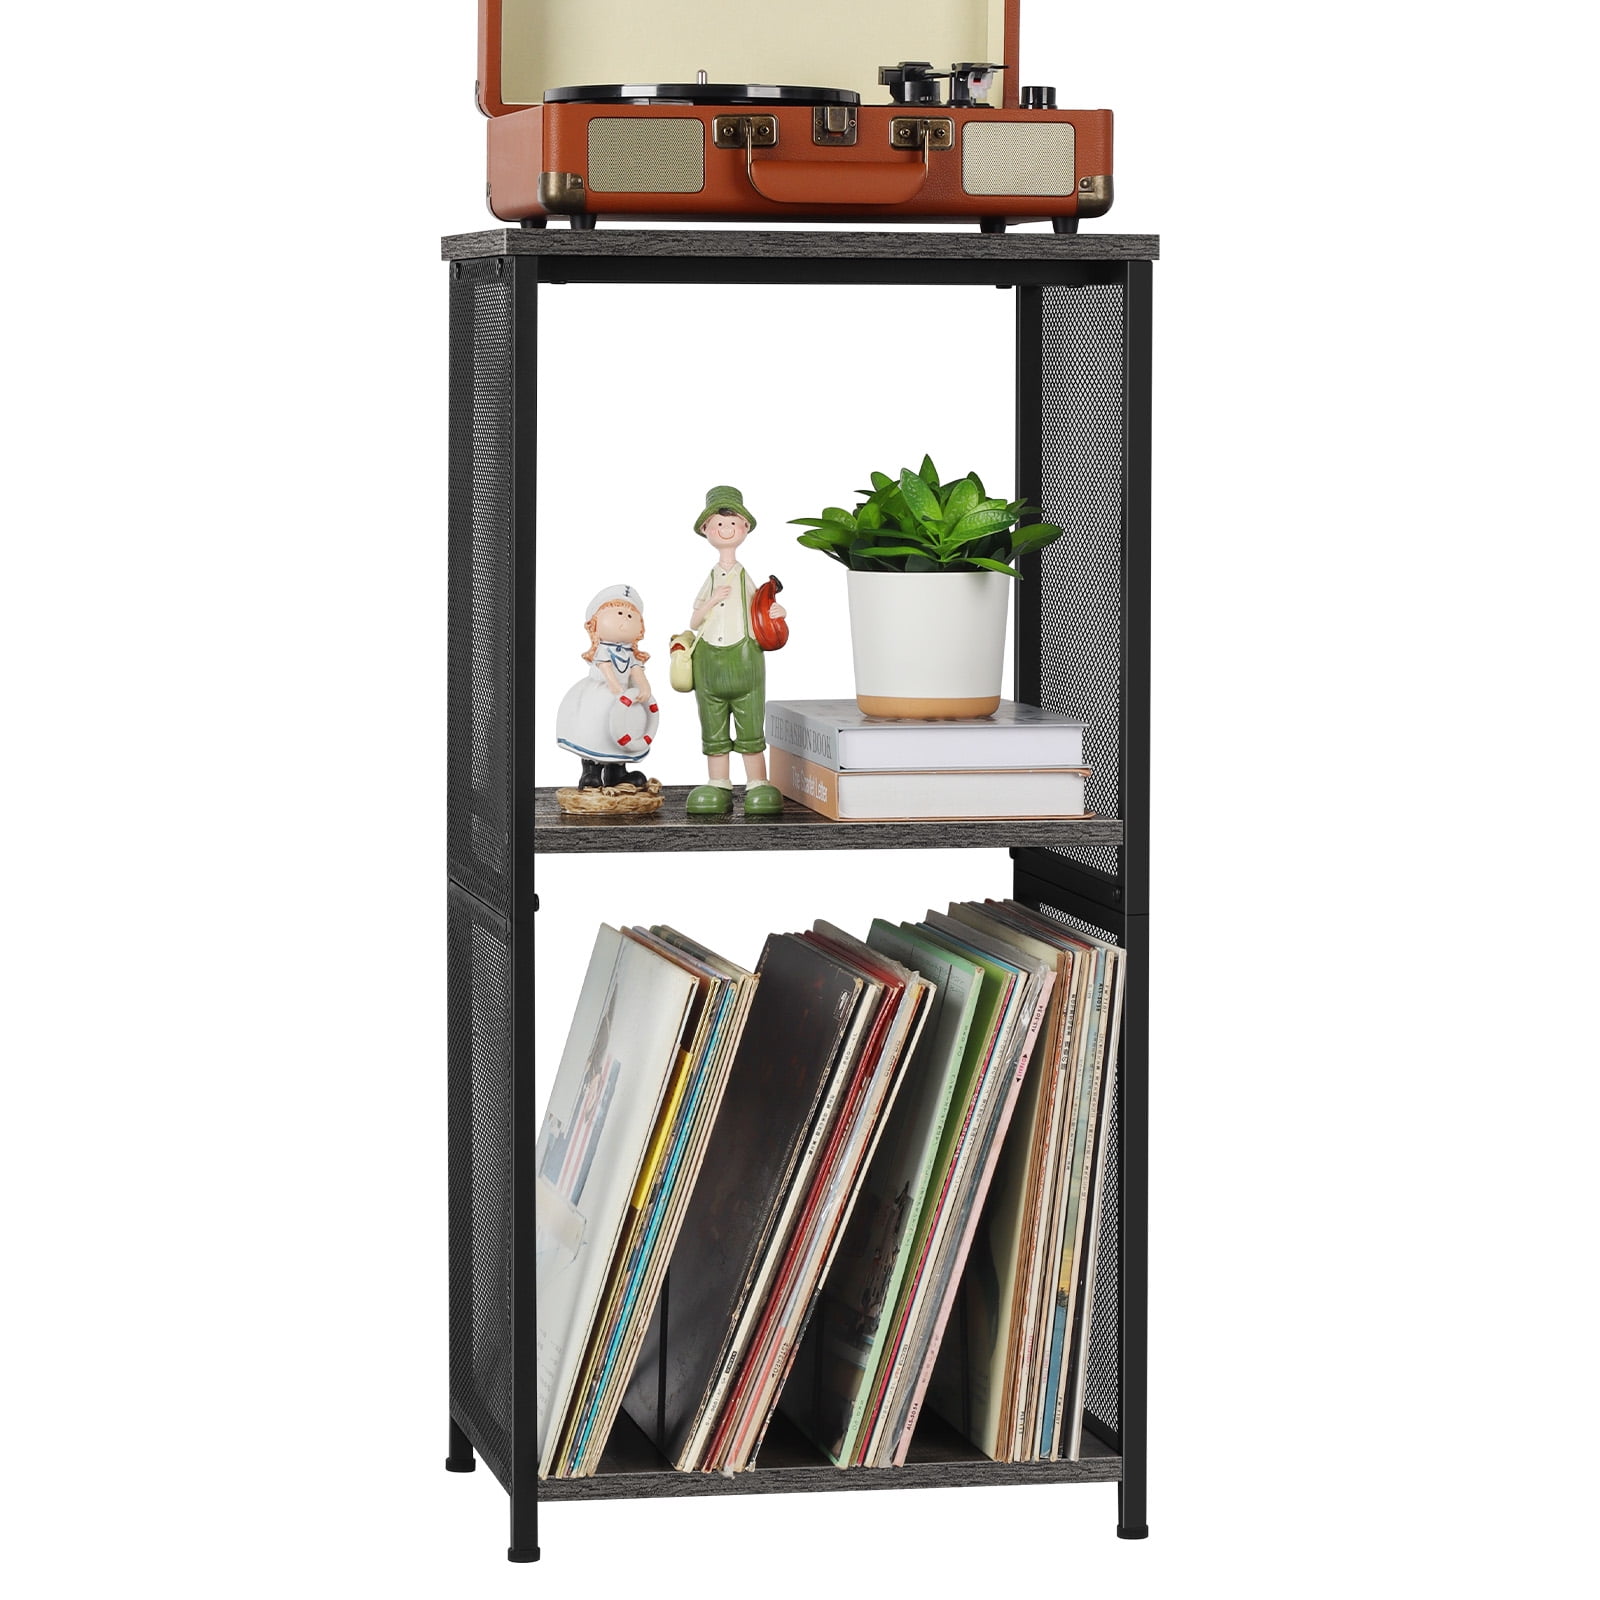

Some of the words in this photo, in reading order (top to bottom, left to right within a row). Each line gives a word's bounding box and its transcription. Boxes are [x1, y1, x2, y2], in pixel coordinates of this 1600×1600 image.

[771, 715, 784, 741] THE
[784, 720, 812, 751] FASHION
[812, 730, 833, 760] BOOK
[791, 765, 801, 789] The
[801, 769, 817, 799] Scarlet
[816, 777, 828, 802] Letter
